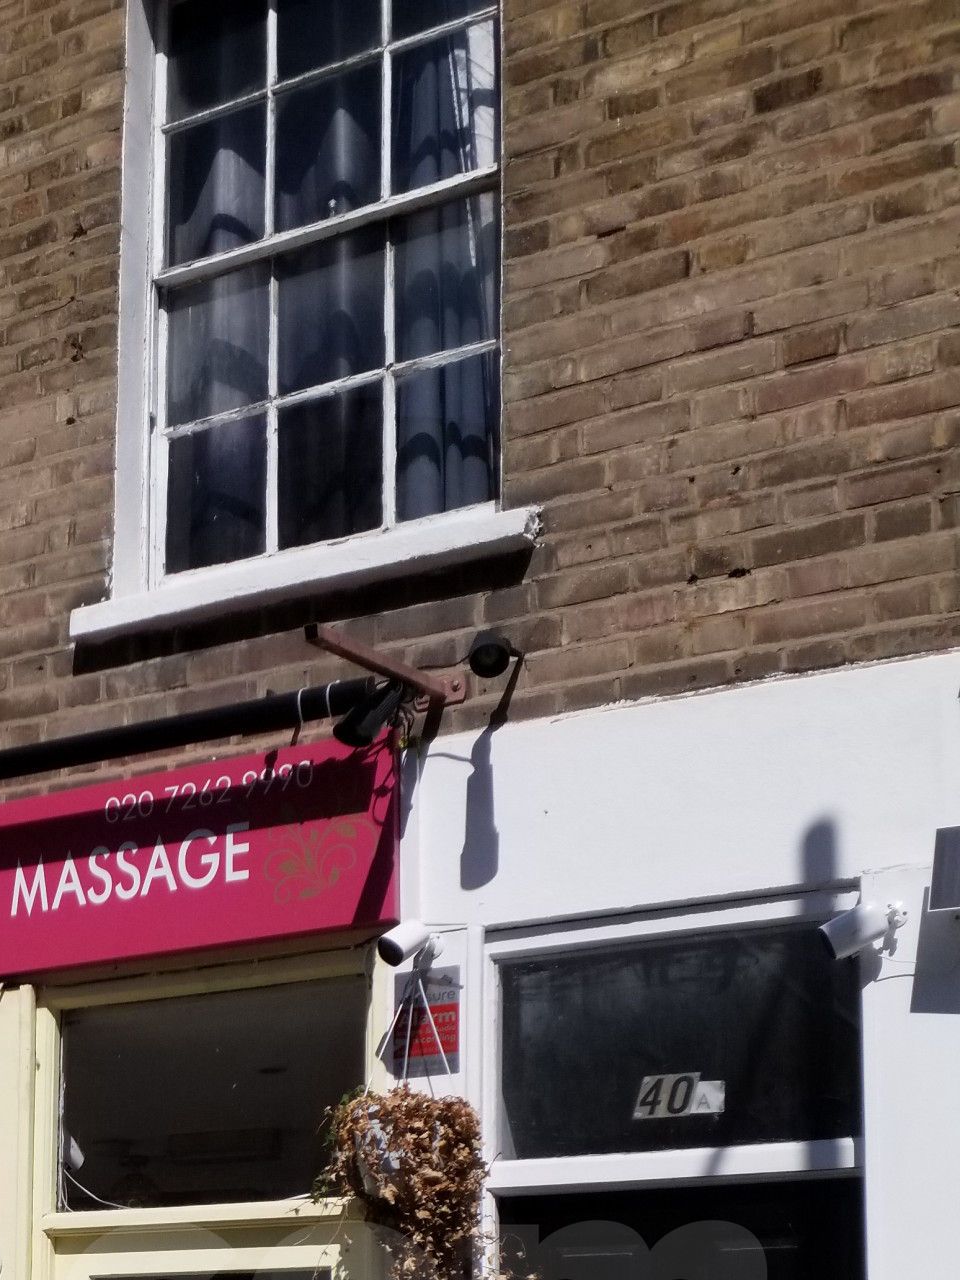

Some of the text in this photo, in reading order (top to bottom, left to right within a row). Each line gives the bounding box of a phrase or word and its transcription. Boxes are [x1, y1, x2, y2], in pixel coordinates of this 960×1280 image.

[105, 760, 313, 823] 020 7262 9990
[11, 821, 250, 918] MASSAGE
